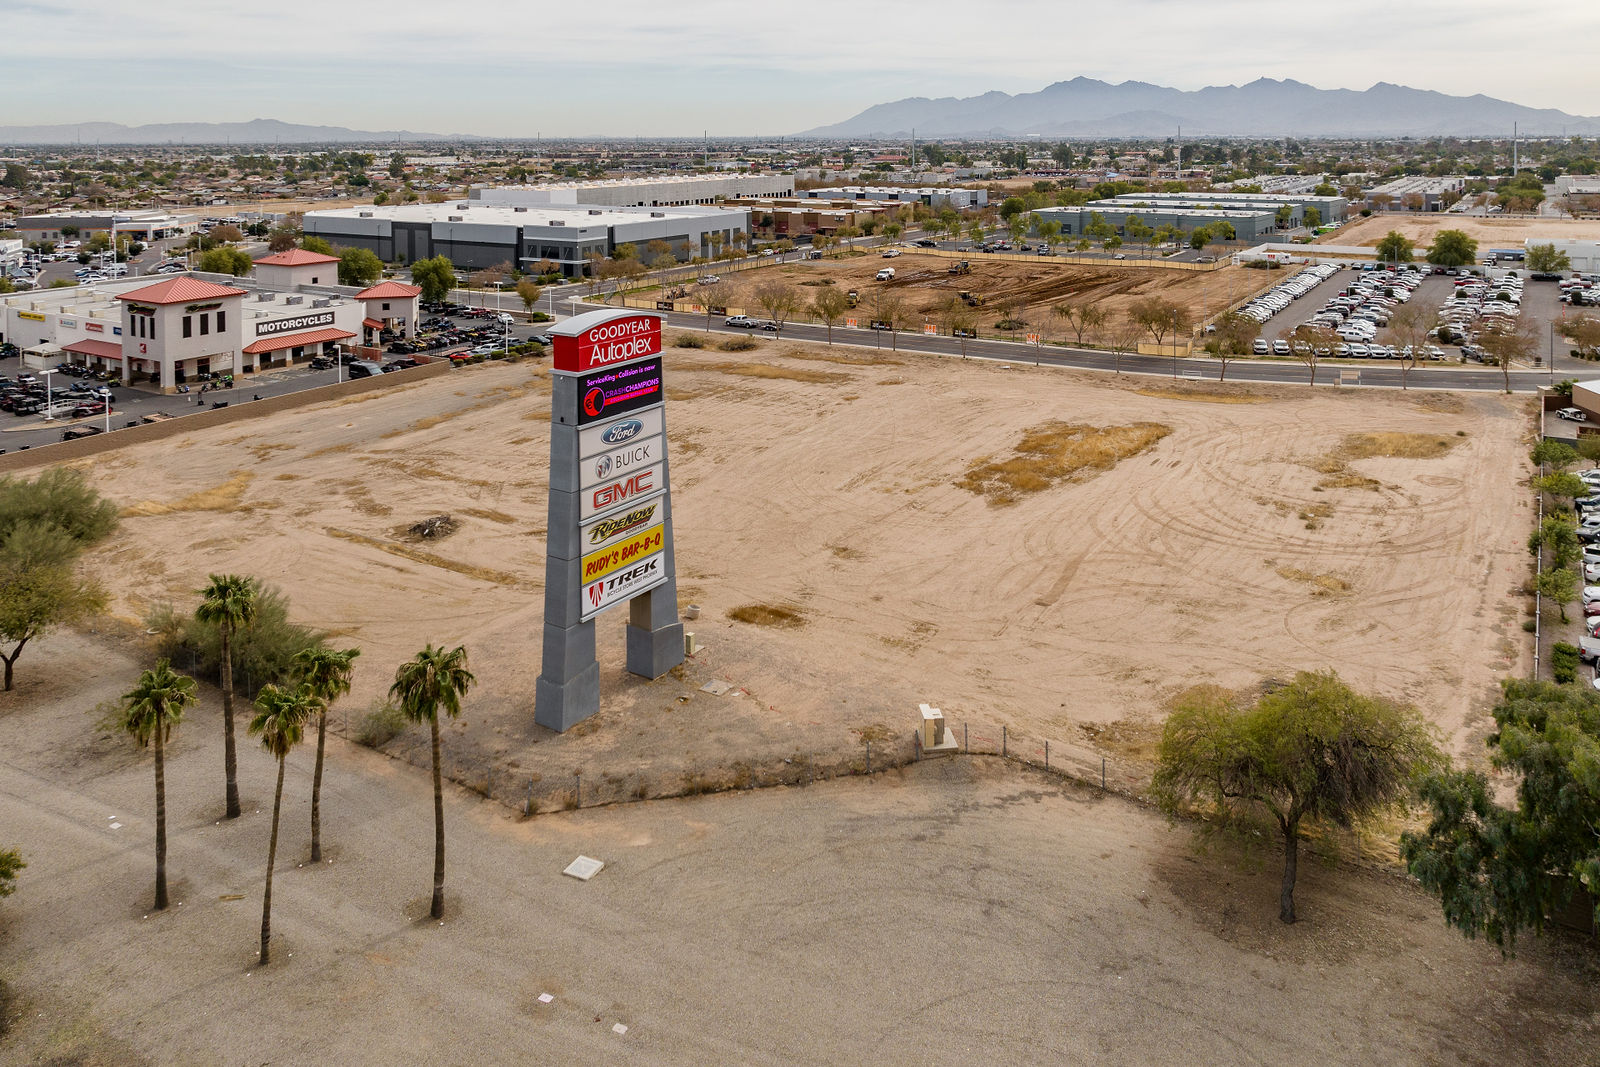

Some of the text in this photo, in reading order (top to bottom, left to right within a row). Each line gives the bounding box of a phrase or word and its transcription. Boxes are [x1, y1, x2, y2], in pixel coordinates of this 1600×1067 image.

[258, 314, 332, 333] MOTORCYCLES
[589, 319, 650, 342] GOODYEAR
[590, 337, 652, 365] Autoplex
[586, 374, 616, 387] ServiceKing
[618, 368, 638, 378] Collision
[609, 422, 636, 441] Ford
[616, 445, 650, 468] BUICK
[593, 471, 653, 509] GMC
[585, 551, 619, 577] RUDY'S
[606, 558, 658, 590] TREK
